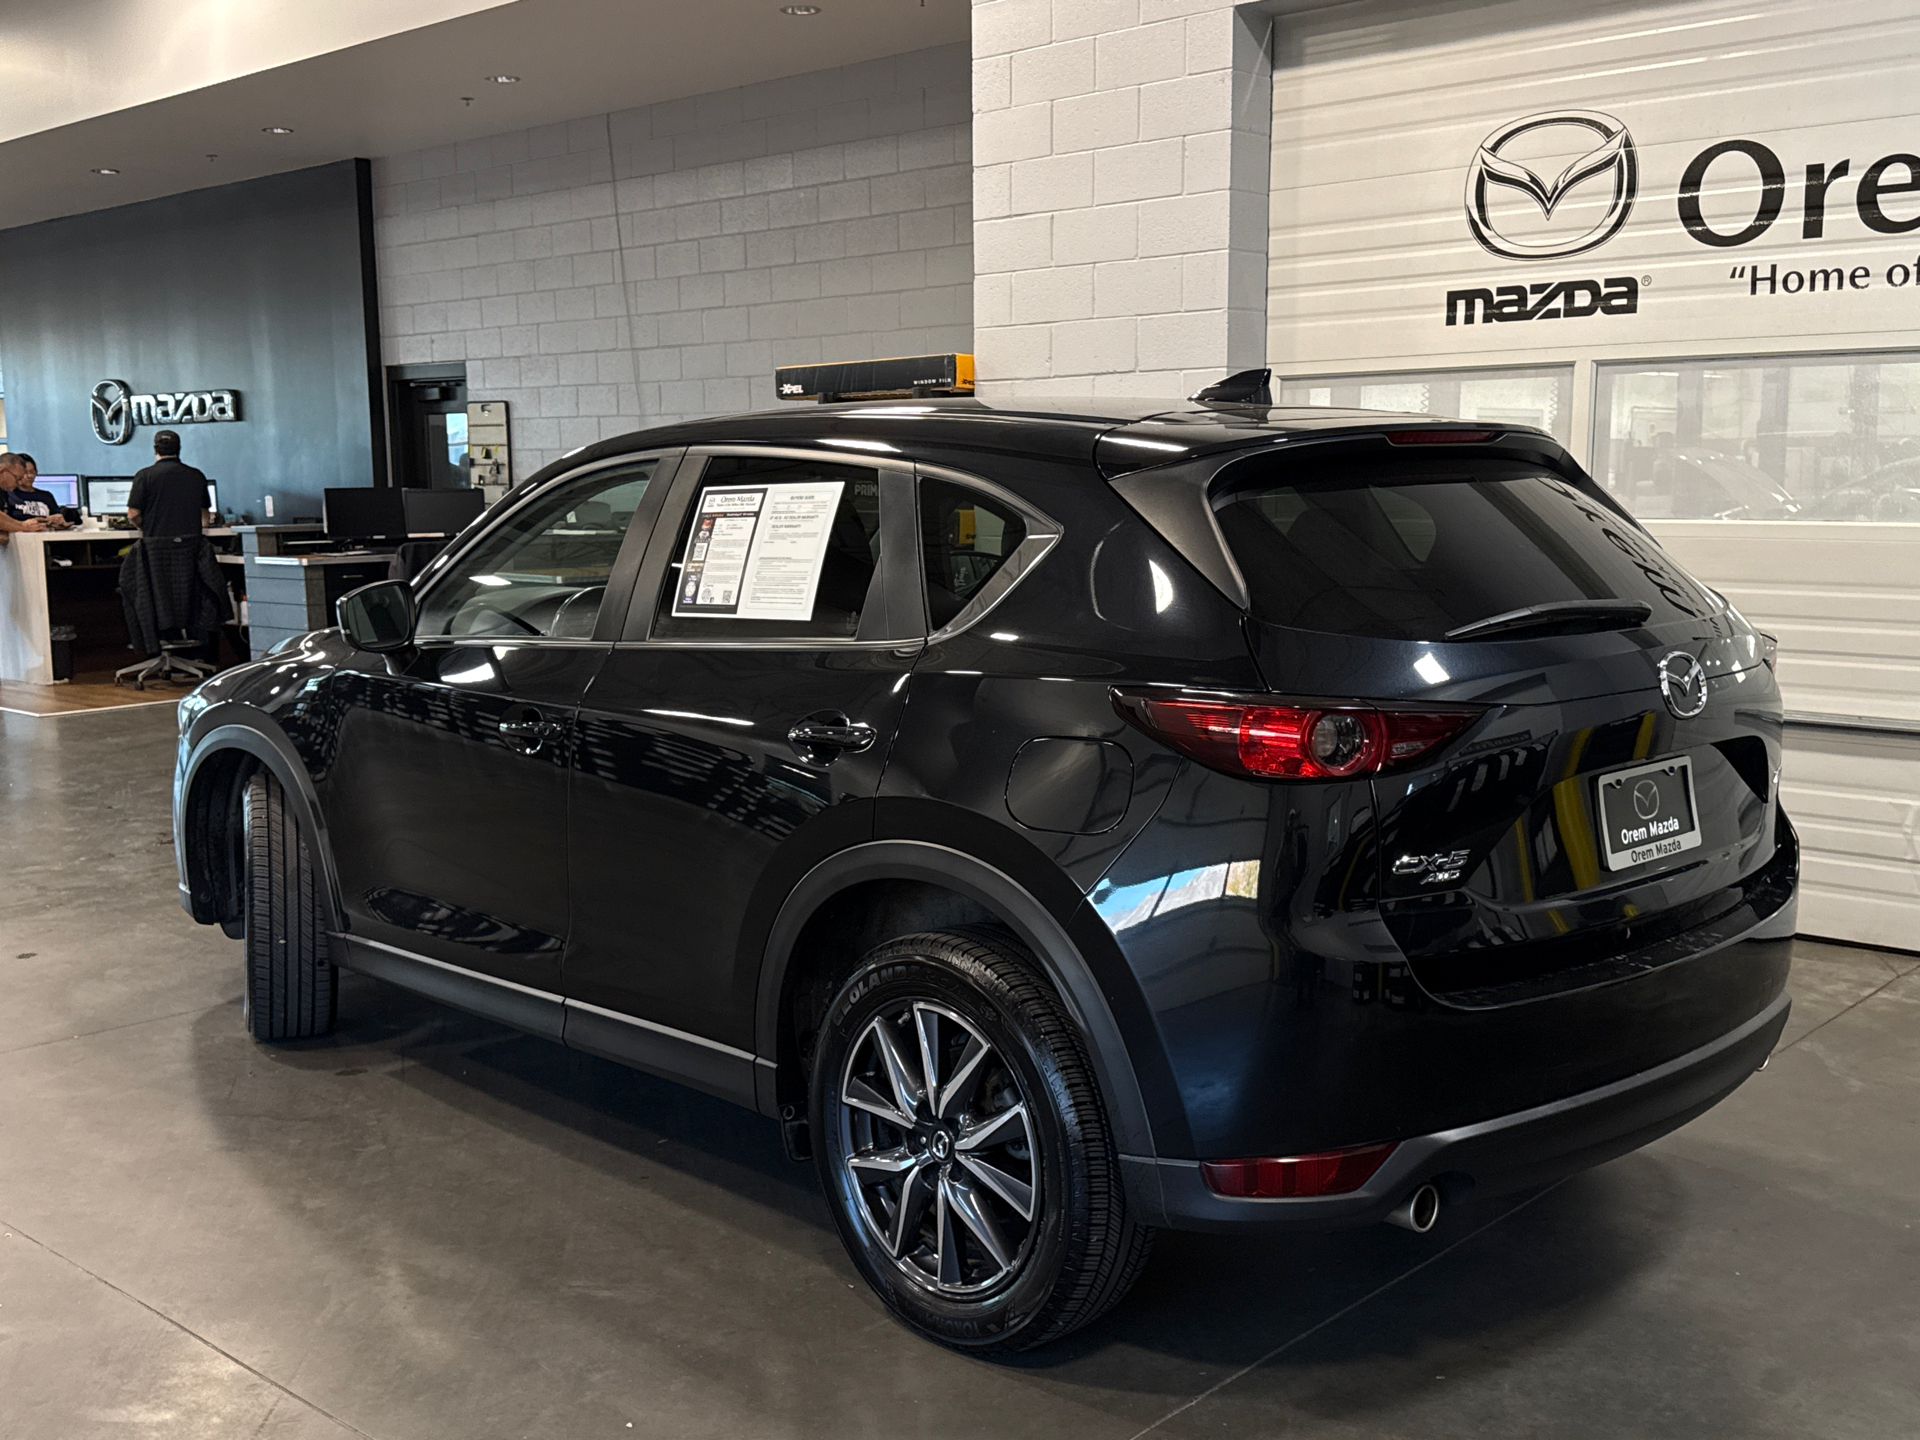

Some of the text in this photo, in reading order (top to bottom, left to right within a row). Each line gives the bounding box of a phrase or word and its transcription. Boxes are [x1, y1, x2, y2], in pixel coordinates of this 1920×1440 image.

[779, 383, 804, 394] XPEL
[1621, 815, 1680, 845] Orem Mazda
[1392, 849, 1471, 875] CX-5
[1630, 839, 1682, 863] Orem Mazda
